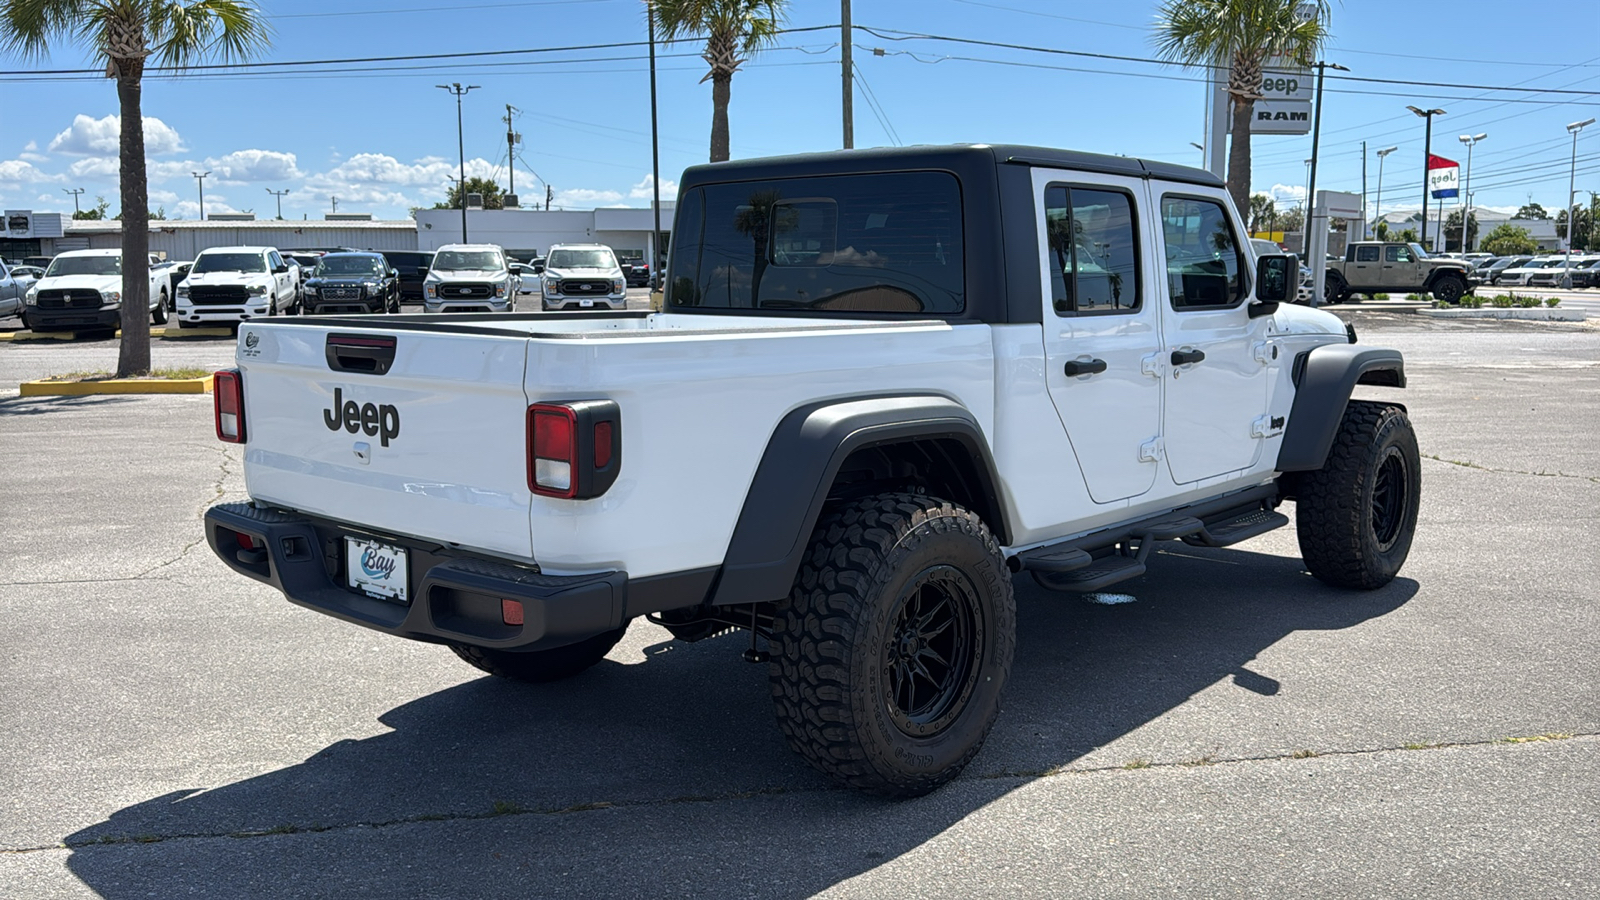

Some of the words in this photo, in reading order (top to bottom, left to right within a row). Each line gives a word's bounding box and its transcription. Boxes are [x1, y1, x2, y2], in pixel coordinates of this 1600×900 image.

[1258, 111, 1308, 121] RAM
[323, 388, 400, 447] Jeep
[363, 545, 396, 581] Bay
